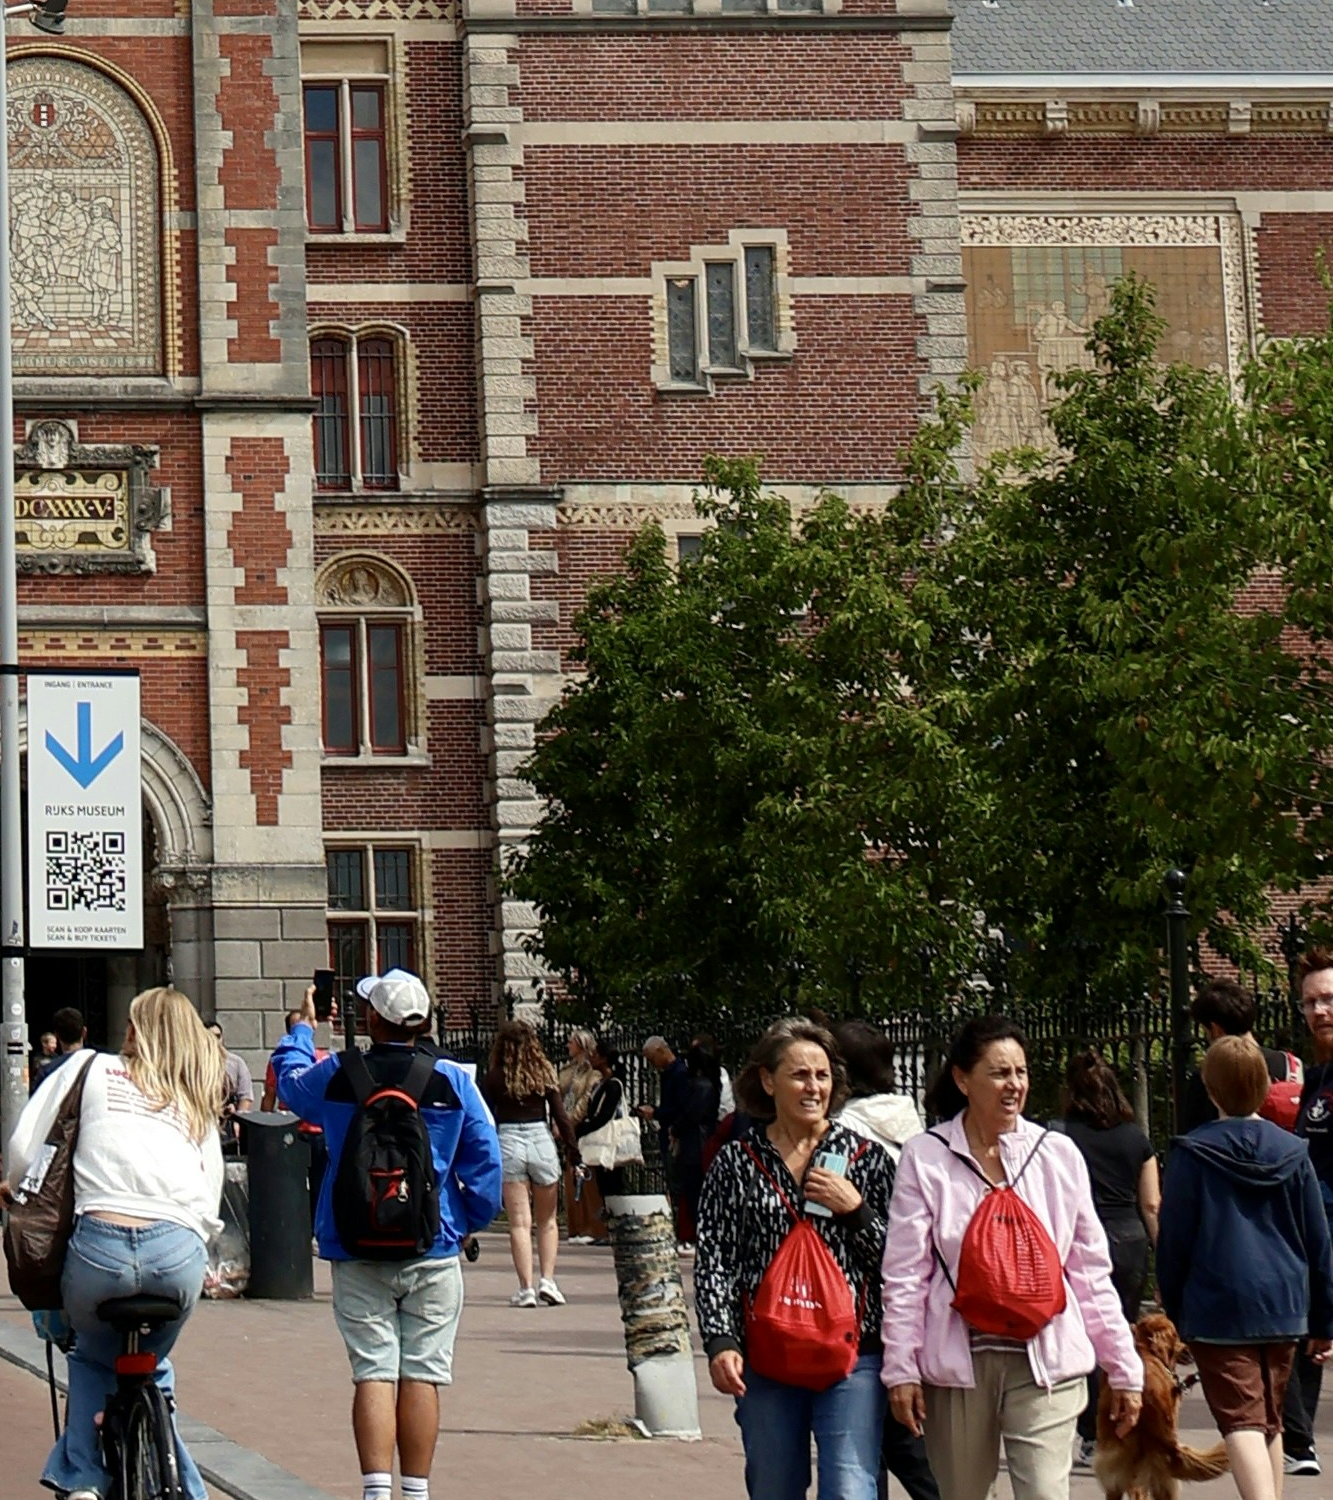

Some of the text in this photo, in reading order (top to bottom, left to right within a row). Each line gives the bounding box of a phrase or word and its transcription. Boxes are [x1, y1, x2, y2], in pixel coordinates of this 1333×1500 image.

[77, 805, 125, 816] MUSEUM
[46, 925, 65, 933] SCAN
[94, 926, 127, 934] KAARTEN
[90, 934, 117, 942] TICKETS
